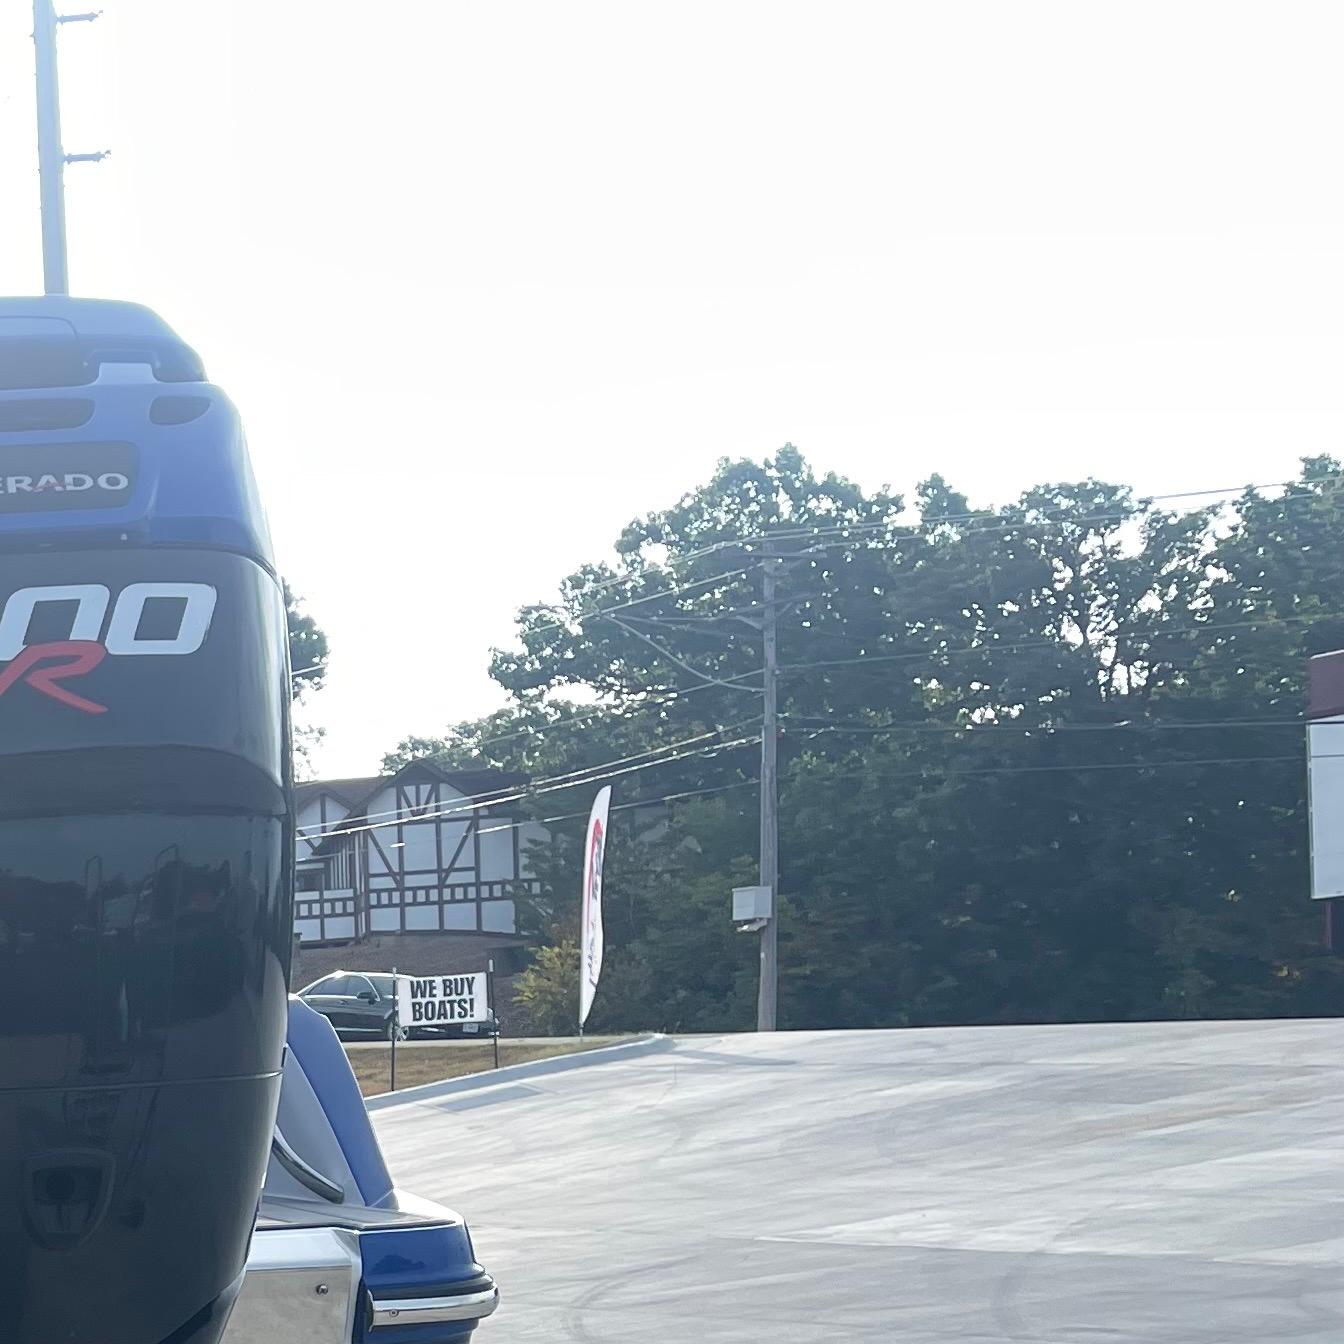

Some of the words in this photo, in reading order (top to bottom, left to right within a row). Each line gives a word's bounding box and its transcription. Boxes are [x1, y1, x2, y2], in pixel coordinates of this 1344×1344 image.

[410, 979, 438, 999] WE
[442, 976, 475, 997] BUY
[412, 998, 475, 1021] BOATS!
